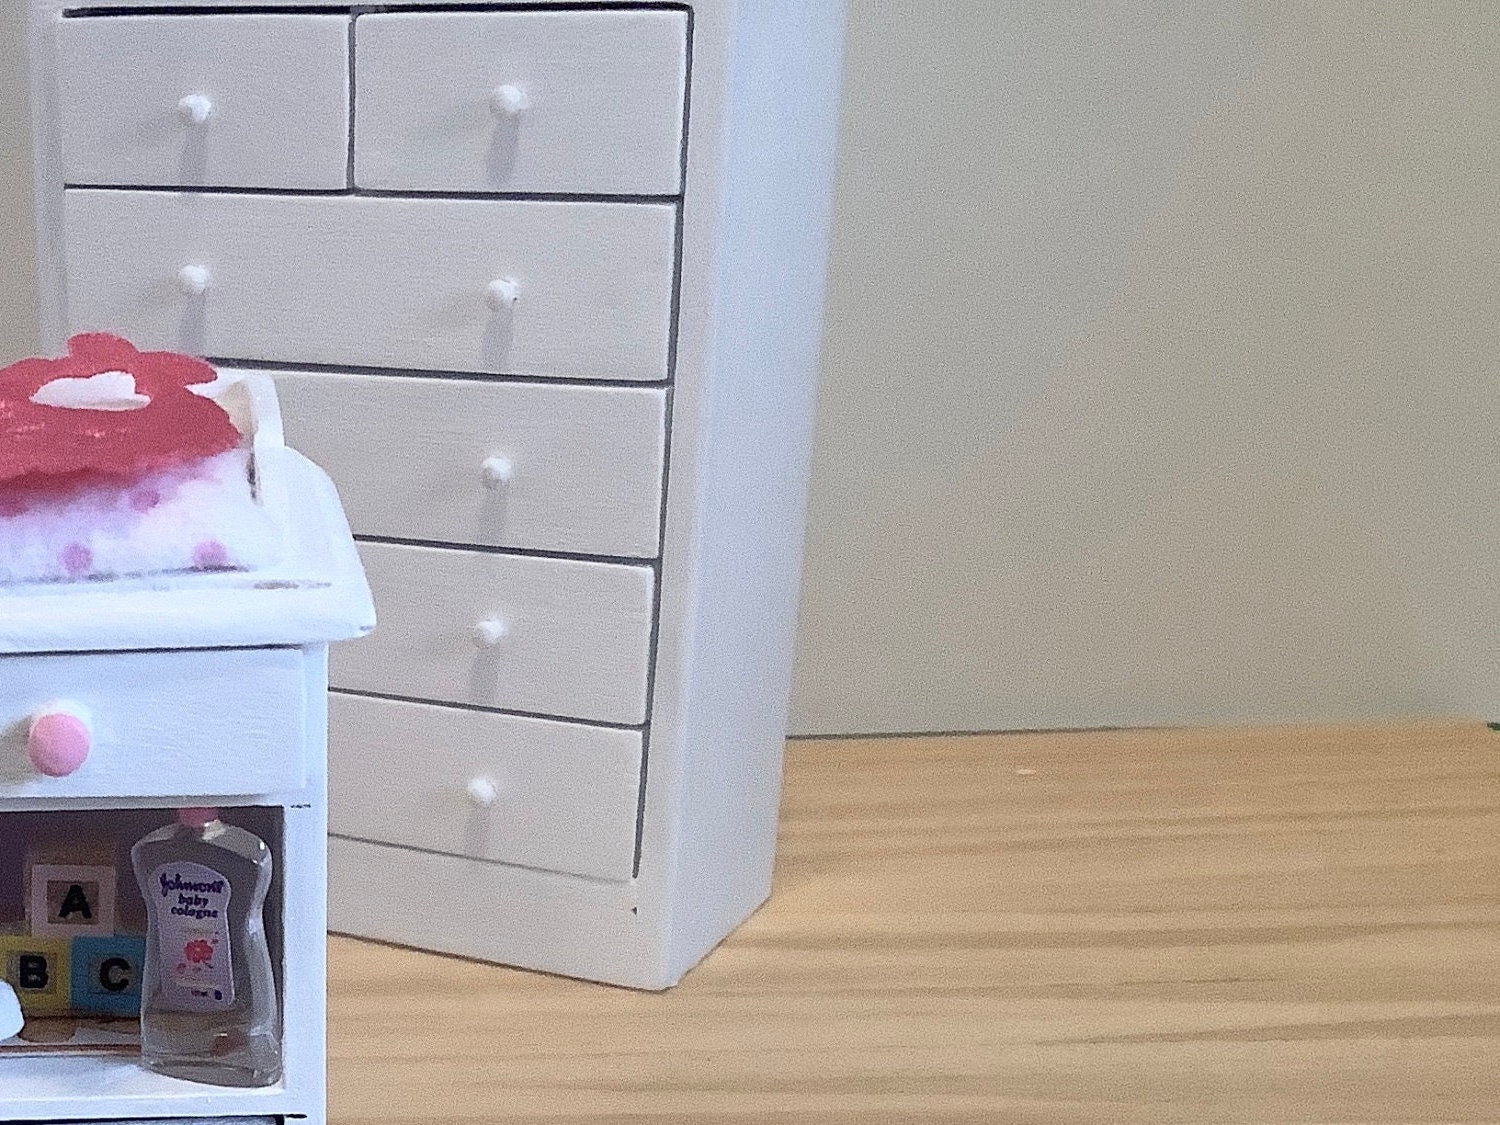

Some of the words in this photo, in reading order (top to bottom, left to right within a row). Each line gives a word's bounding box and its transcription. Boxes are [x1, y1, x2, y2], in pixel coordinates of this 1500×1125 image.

[58, 884, 92, 919] A
[171, 905, 218, 919] cologne
[178, 893, 209, 908] baby
[19, 955, 49, 989] B
[99, 957, 131, 992] C
